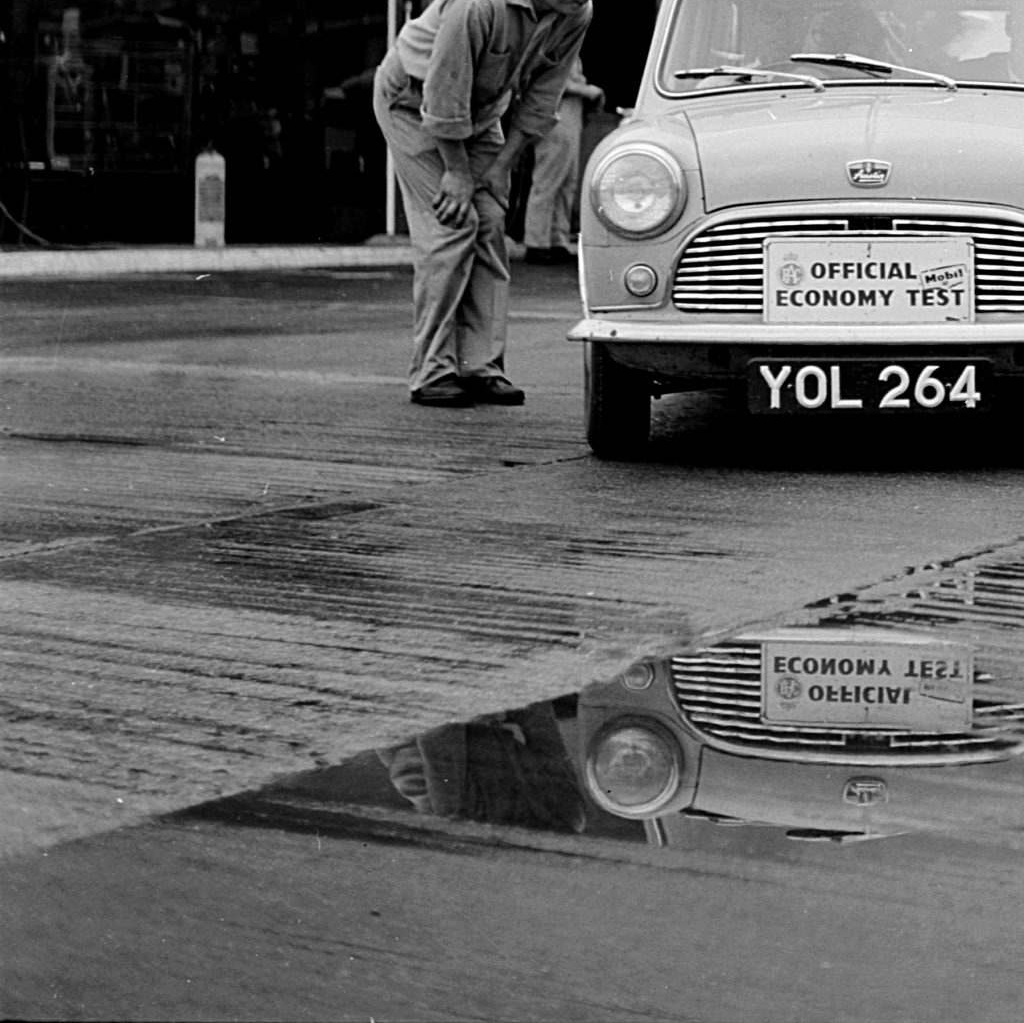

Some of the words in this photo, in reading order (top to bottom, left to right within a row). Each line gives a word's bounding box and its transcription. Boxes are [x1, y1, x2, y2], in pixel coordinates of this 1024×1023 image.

[810, 262, 917, 280] OFFICIAL
[924, 268, 964, 284] Mobil
[775, 289, 893, 307] ECONOMY
[906, 289, 965, 307] TEST
[759, 365, 863, 409] YOL
[878, 365, 981, 409] 264
